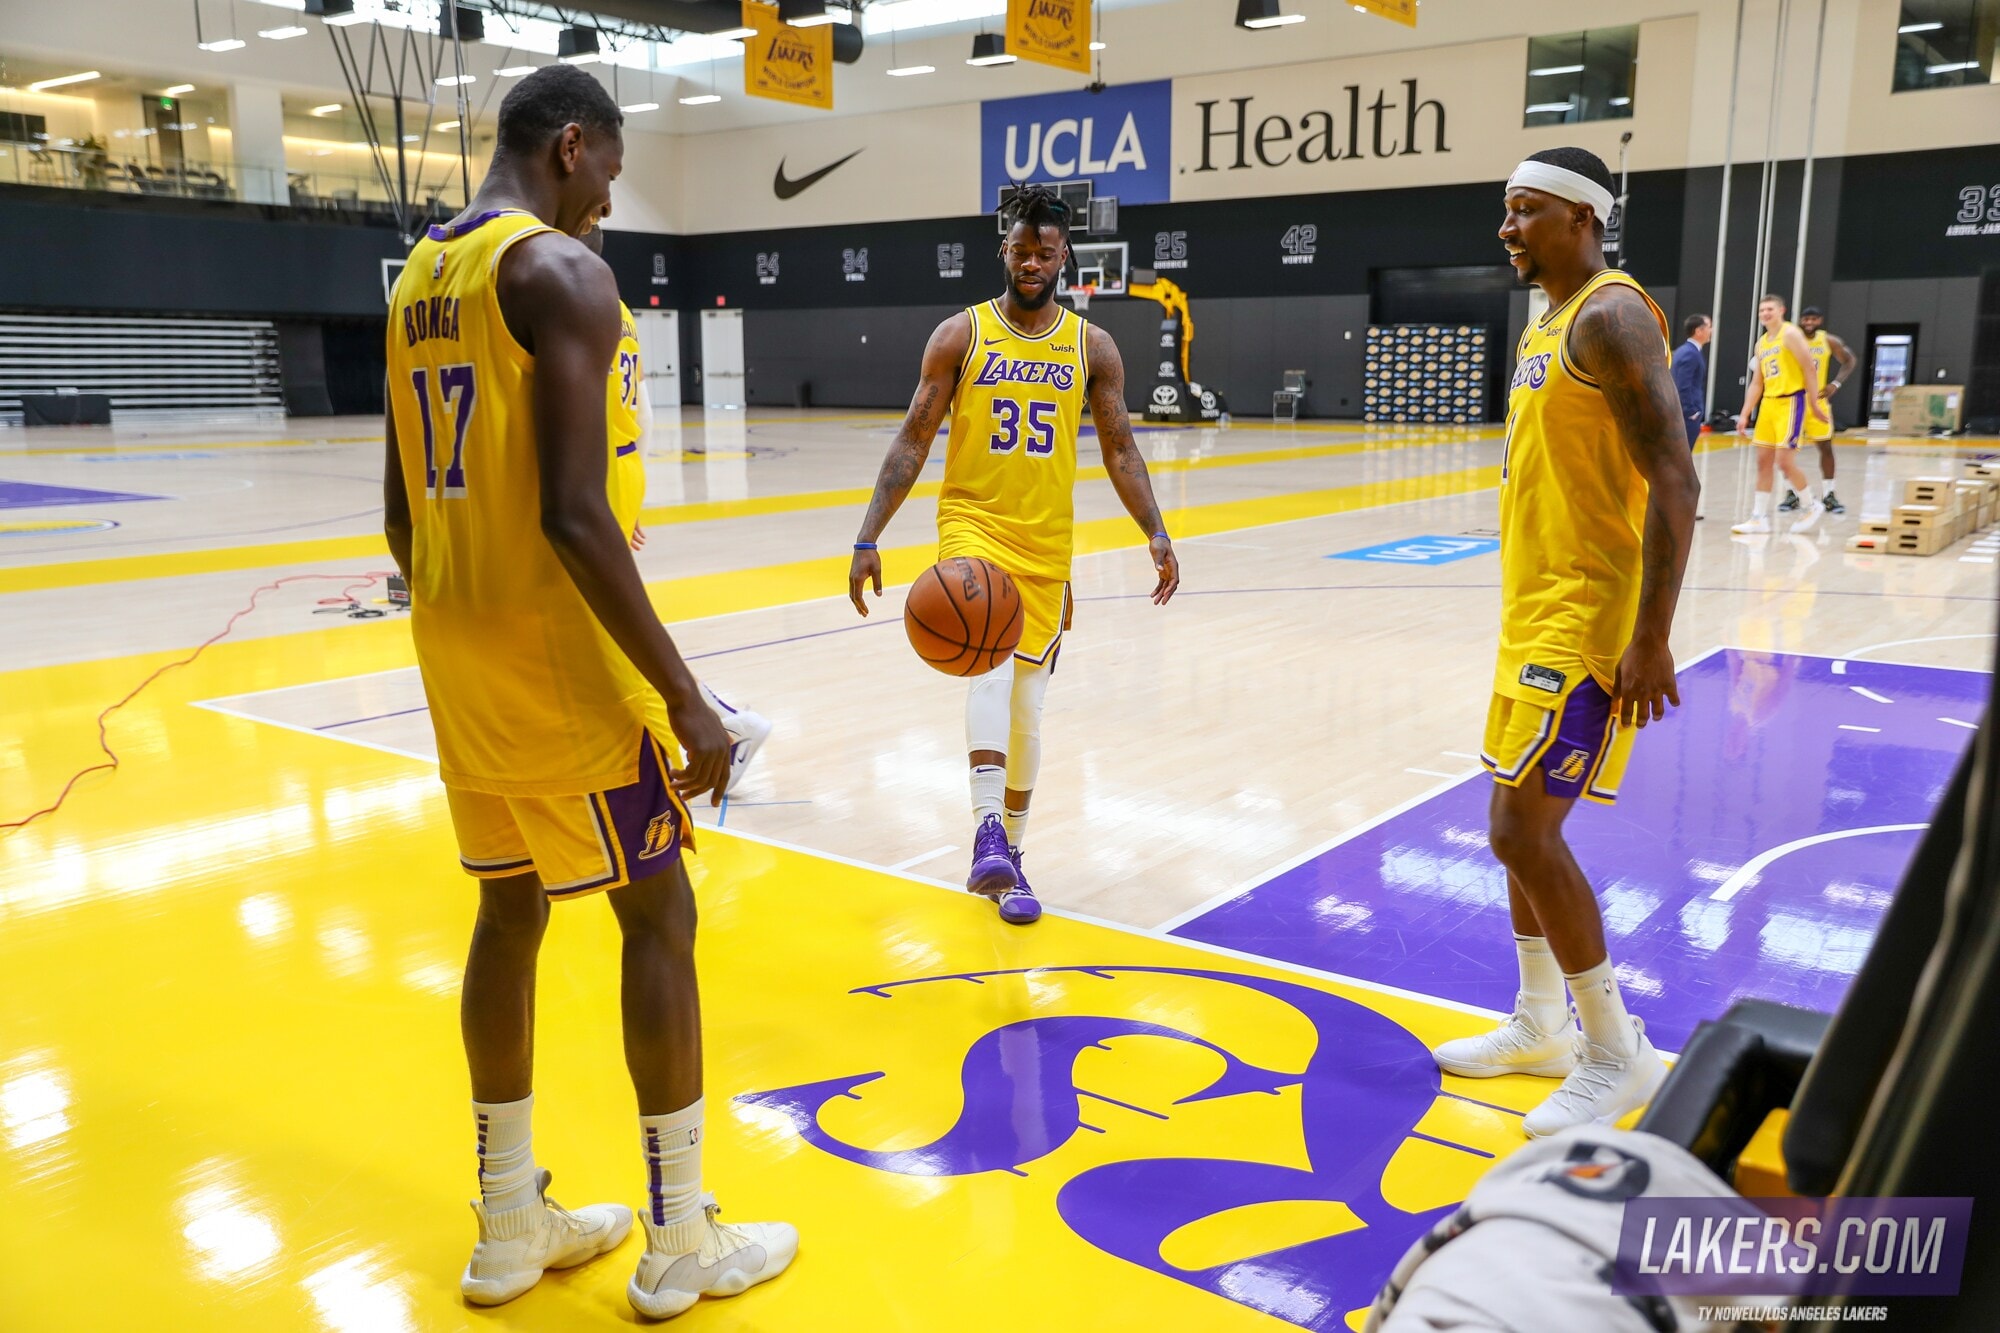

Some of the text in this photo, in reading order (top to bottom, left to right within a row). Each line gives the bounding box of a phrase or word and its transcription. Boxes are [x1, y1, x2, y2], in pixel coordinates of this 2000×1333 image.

[1005, 78, 1452, 181] UCLA Health
[1154, 231, 1187, 260] 25
[1280, 223, 1317, 254] 42
[756, 252, 779, 277] 24
[842, 247, 868, 273] 34
[937, 242, 965, 270] 52
[404, 296, 460, 347] BONGA
[1050, 342, 1075, 353] wish
[619, 350, 638, 411] 31
[973, 351, 1075, 391] LAKERS
[1149, 404, 1181, 415] TOYOTA
[411, 362, 478, 499] 17
[989, 396, 1058, 459] 35
